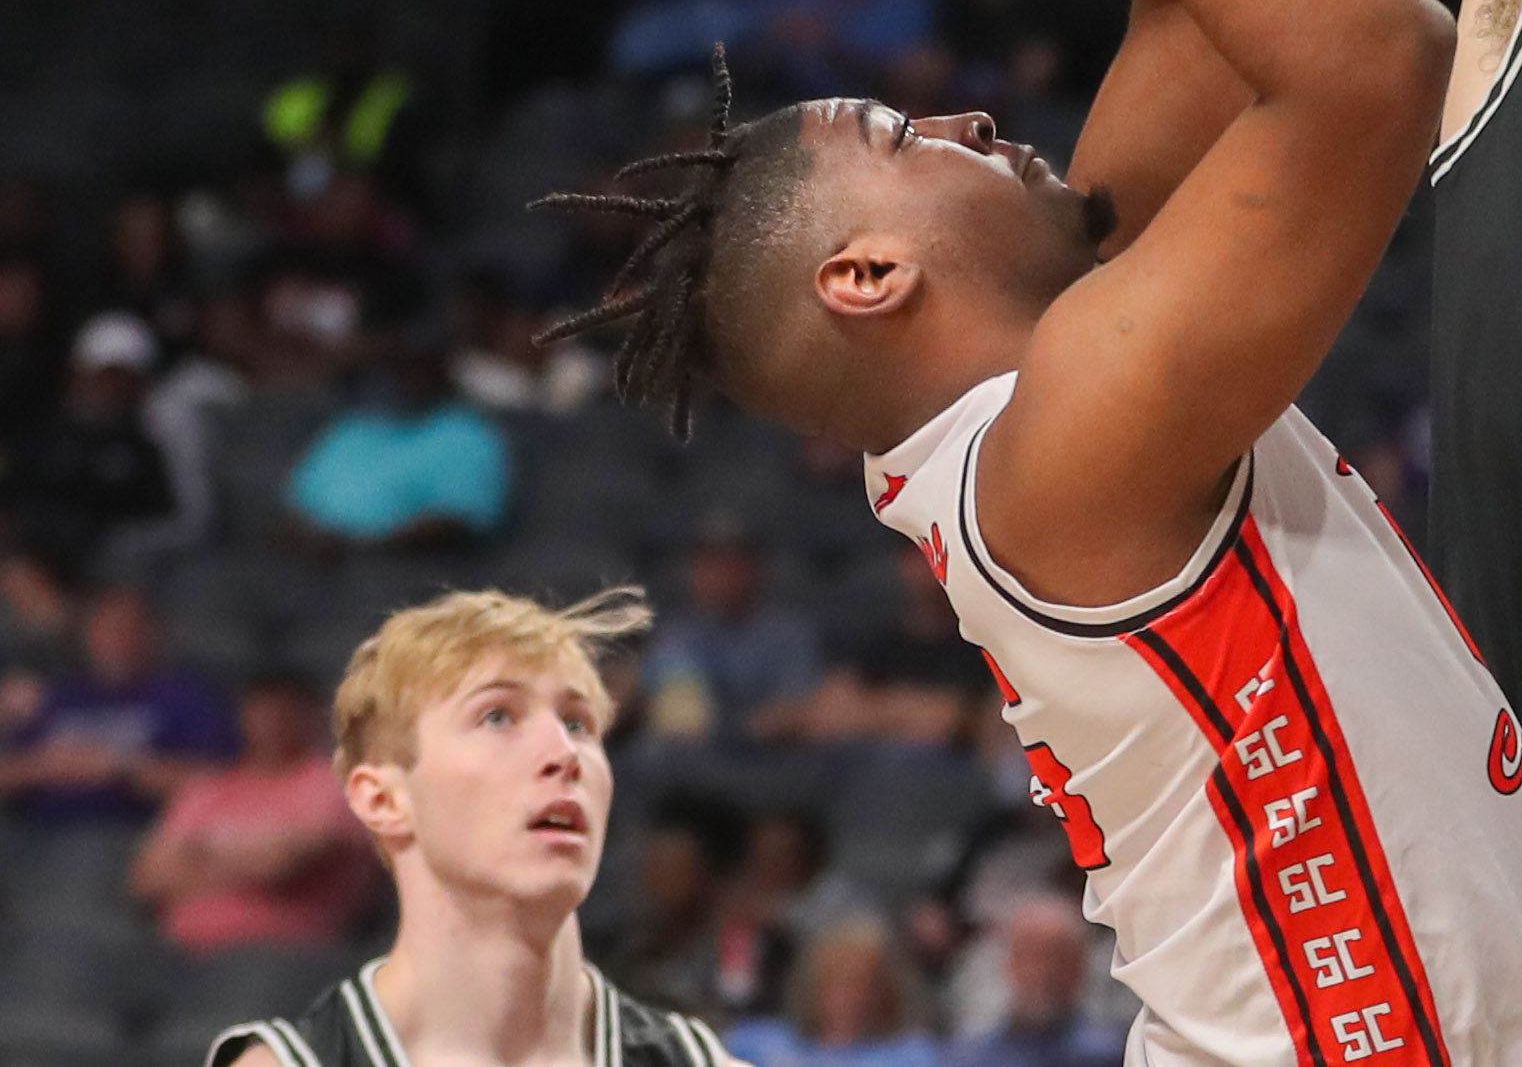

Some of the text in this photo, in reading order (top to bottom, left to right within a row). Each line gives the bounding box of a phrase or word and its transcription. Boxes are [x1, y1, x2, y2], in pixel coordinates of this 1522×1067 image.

[1233, 714, 1304, 781] SC
[1263, 786, 1323, 849] SC
[1277, 853, 1348, 914] SC
[1302, 927, 1376, 990] SC
[1330, 1001, 1406, 1063] SC
